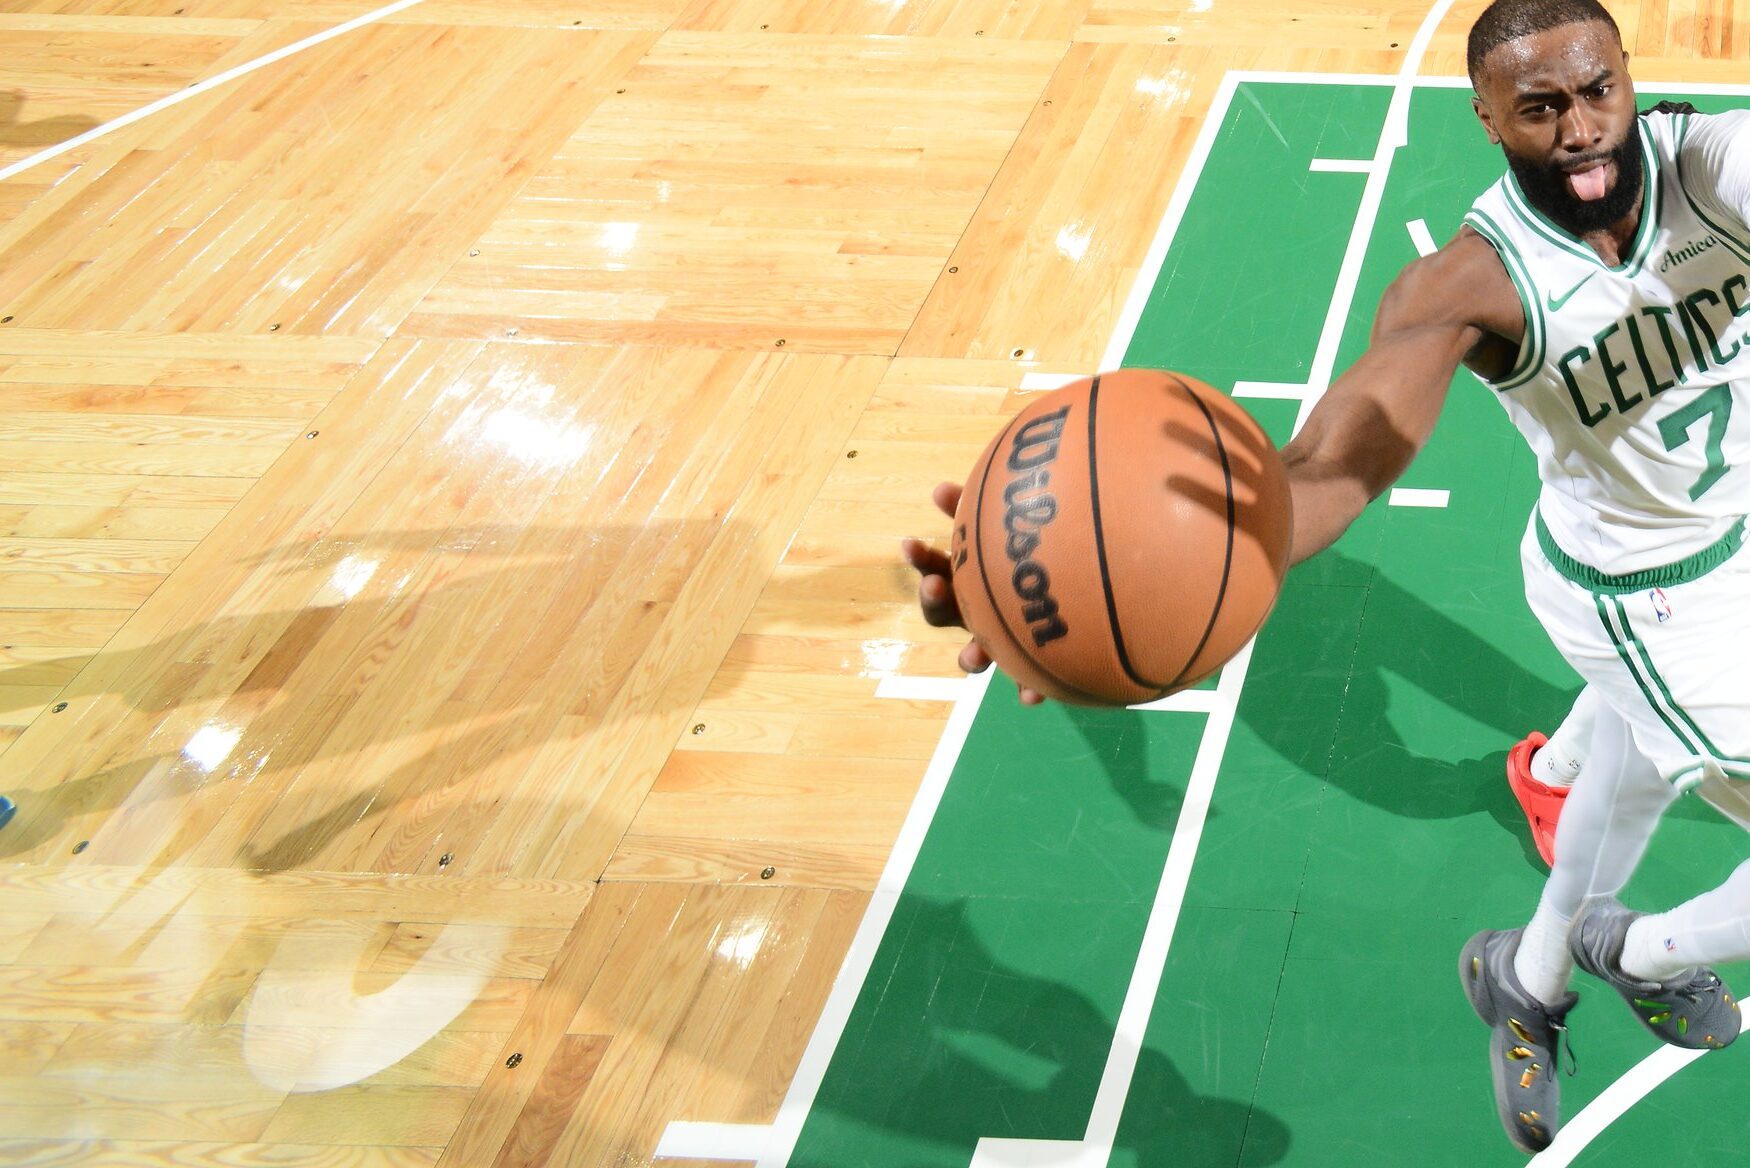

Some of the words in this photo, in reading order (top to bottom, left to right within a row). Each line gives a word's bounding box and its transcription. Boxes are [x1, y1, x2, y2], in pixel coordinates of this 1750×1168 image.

[1659, 233, 1717, 274] Amica
[1656, 381, 1734, 503] 7
[1002, 404, 1073, 649] Wilson
